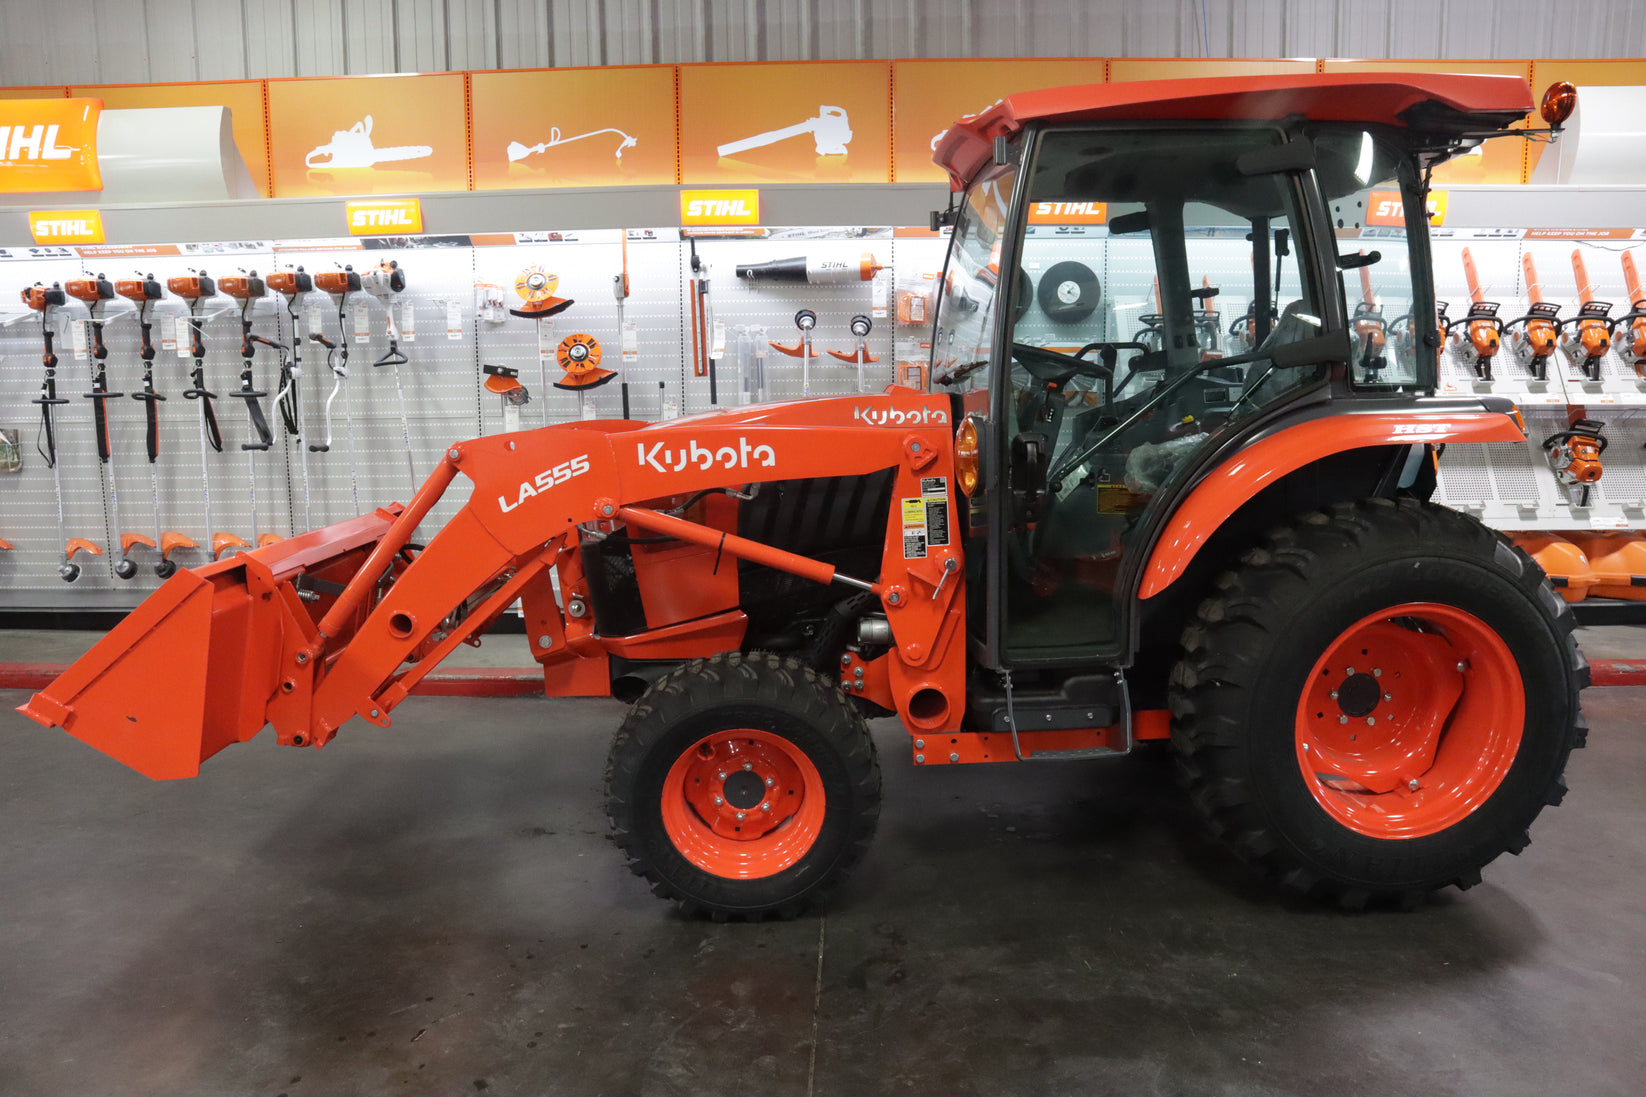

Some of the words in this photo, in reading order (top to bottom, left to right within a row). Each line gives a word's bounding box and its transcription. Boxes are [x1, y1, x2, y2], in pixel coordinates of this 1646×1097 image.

[686, 200, 751, 216] STIHL
[1036, 202, 1100, 215] STIHL
[1376, 201, 1442, 216] STIL
[352, 209, 413, 226] STIHL
[35, 219, 94, 236] STIHL
[853, 405, 948, 425] Kubota
[1392, 423, 1452, 434] HST
[637, 437, 776, 473] Kubota
[498, 454, 590, 513] LA555
